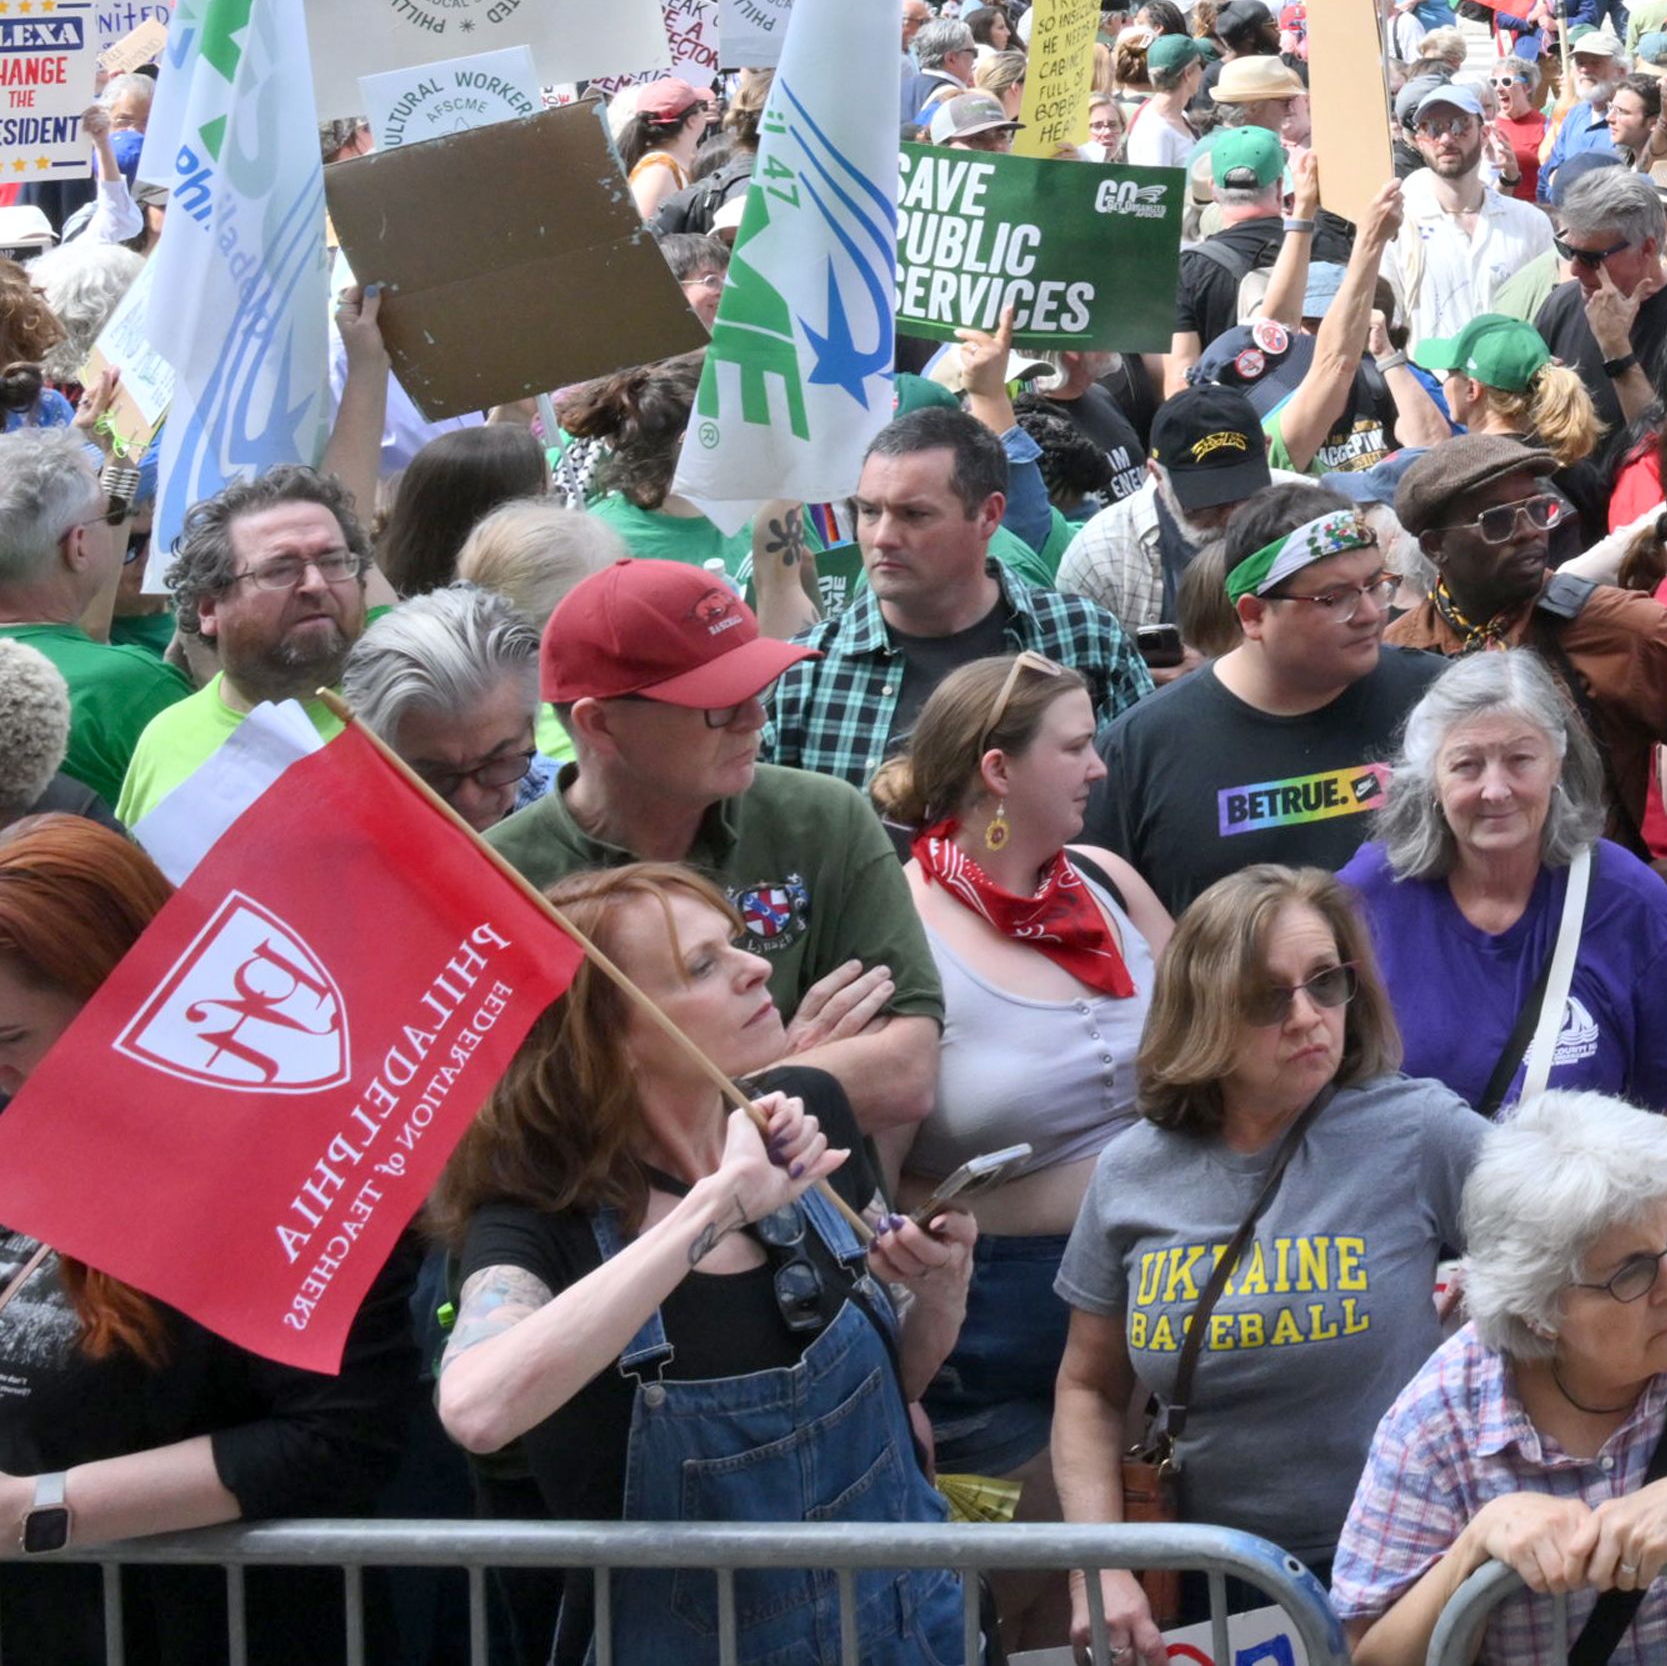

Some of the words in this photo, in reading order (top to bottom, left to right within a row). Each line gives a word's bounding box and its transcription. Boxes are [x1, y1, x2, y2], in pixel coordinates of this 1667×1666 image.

[0, 24, 82, 50] LEXA
[1043, 36, 1059, 54] HE
[0, 56, 68, 85] HANGE
[9, 90, 35, 108] THE
[1039, 81, 1070, 101] FULL
[385, 78, 444, 146] ULTURAL
[454, 71, 534, 115] WORKER
[426, 97, 488, 123] AFSCME
[0, 115, 83, 146] SIDENT
[762, 153, 800, 208] 47
[1227, 779, 1348, 824] BETRUE.
